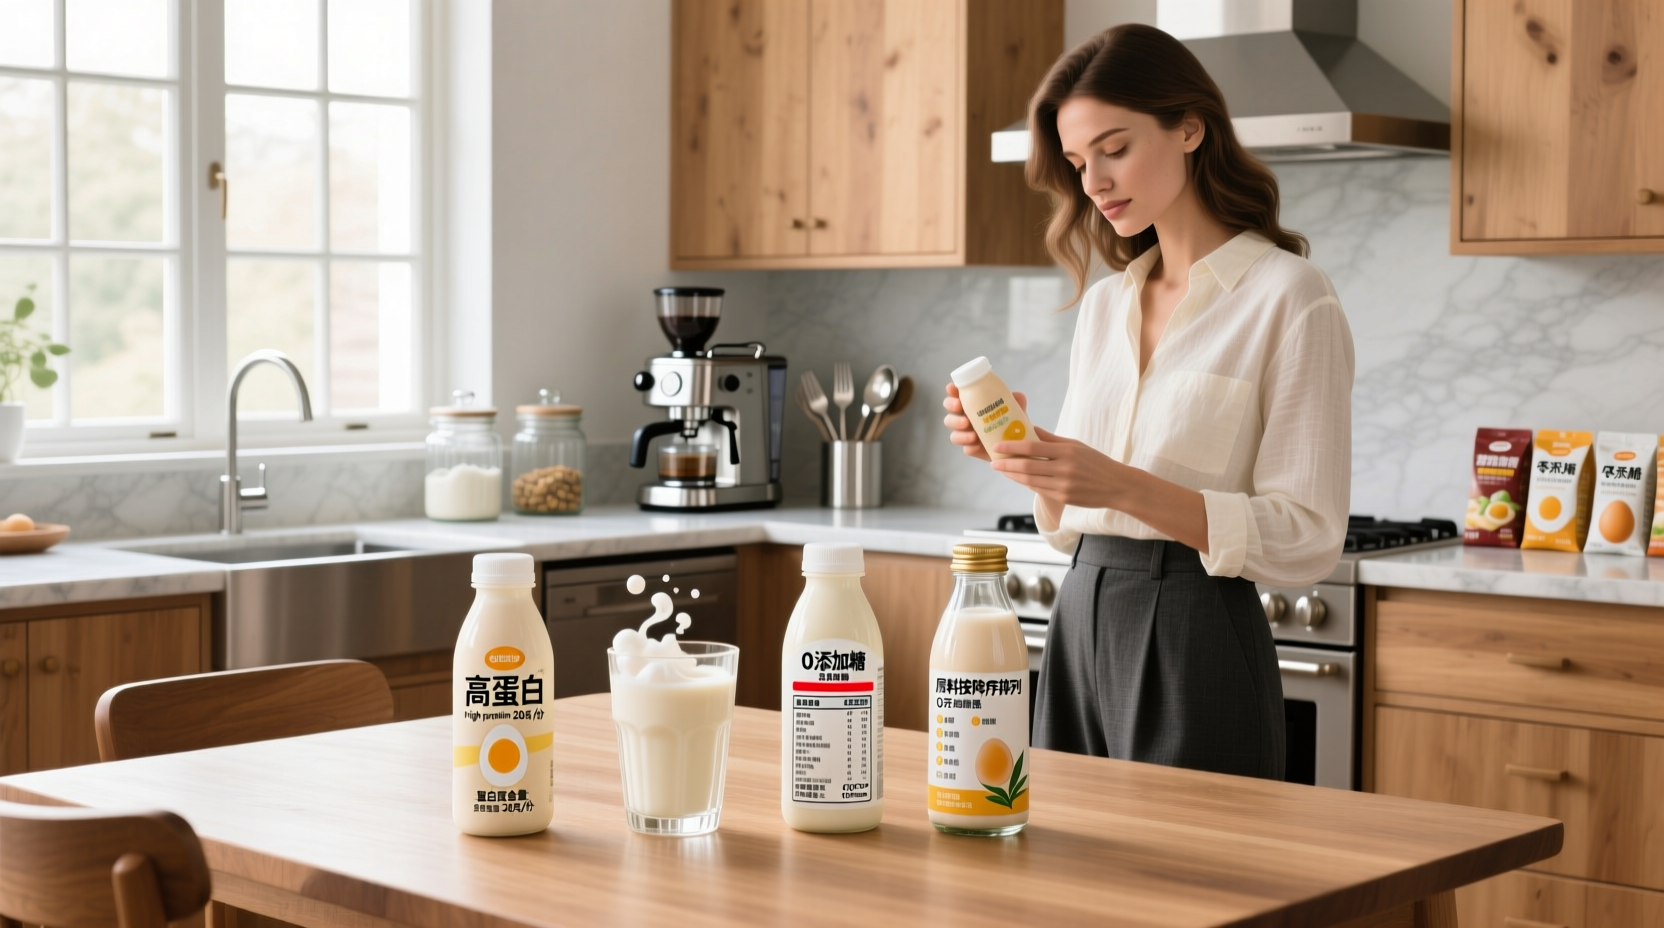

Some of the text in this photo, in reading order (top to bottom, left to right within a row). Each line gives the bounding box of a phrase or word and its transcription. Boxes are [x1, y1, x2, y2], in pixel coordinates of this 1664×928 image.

[801, 649, 866, 671] 0添加糖
[465, 674, 543, 706] 高蛋白
